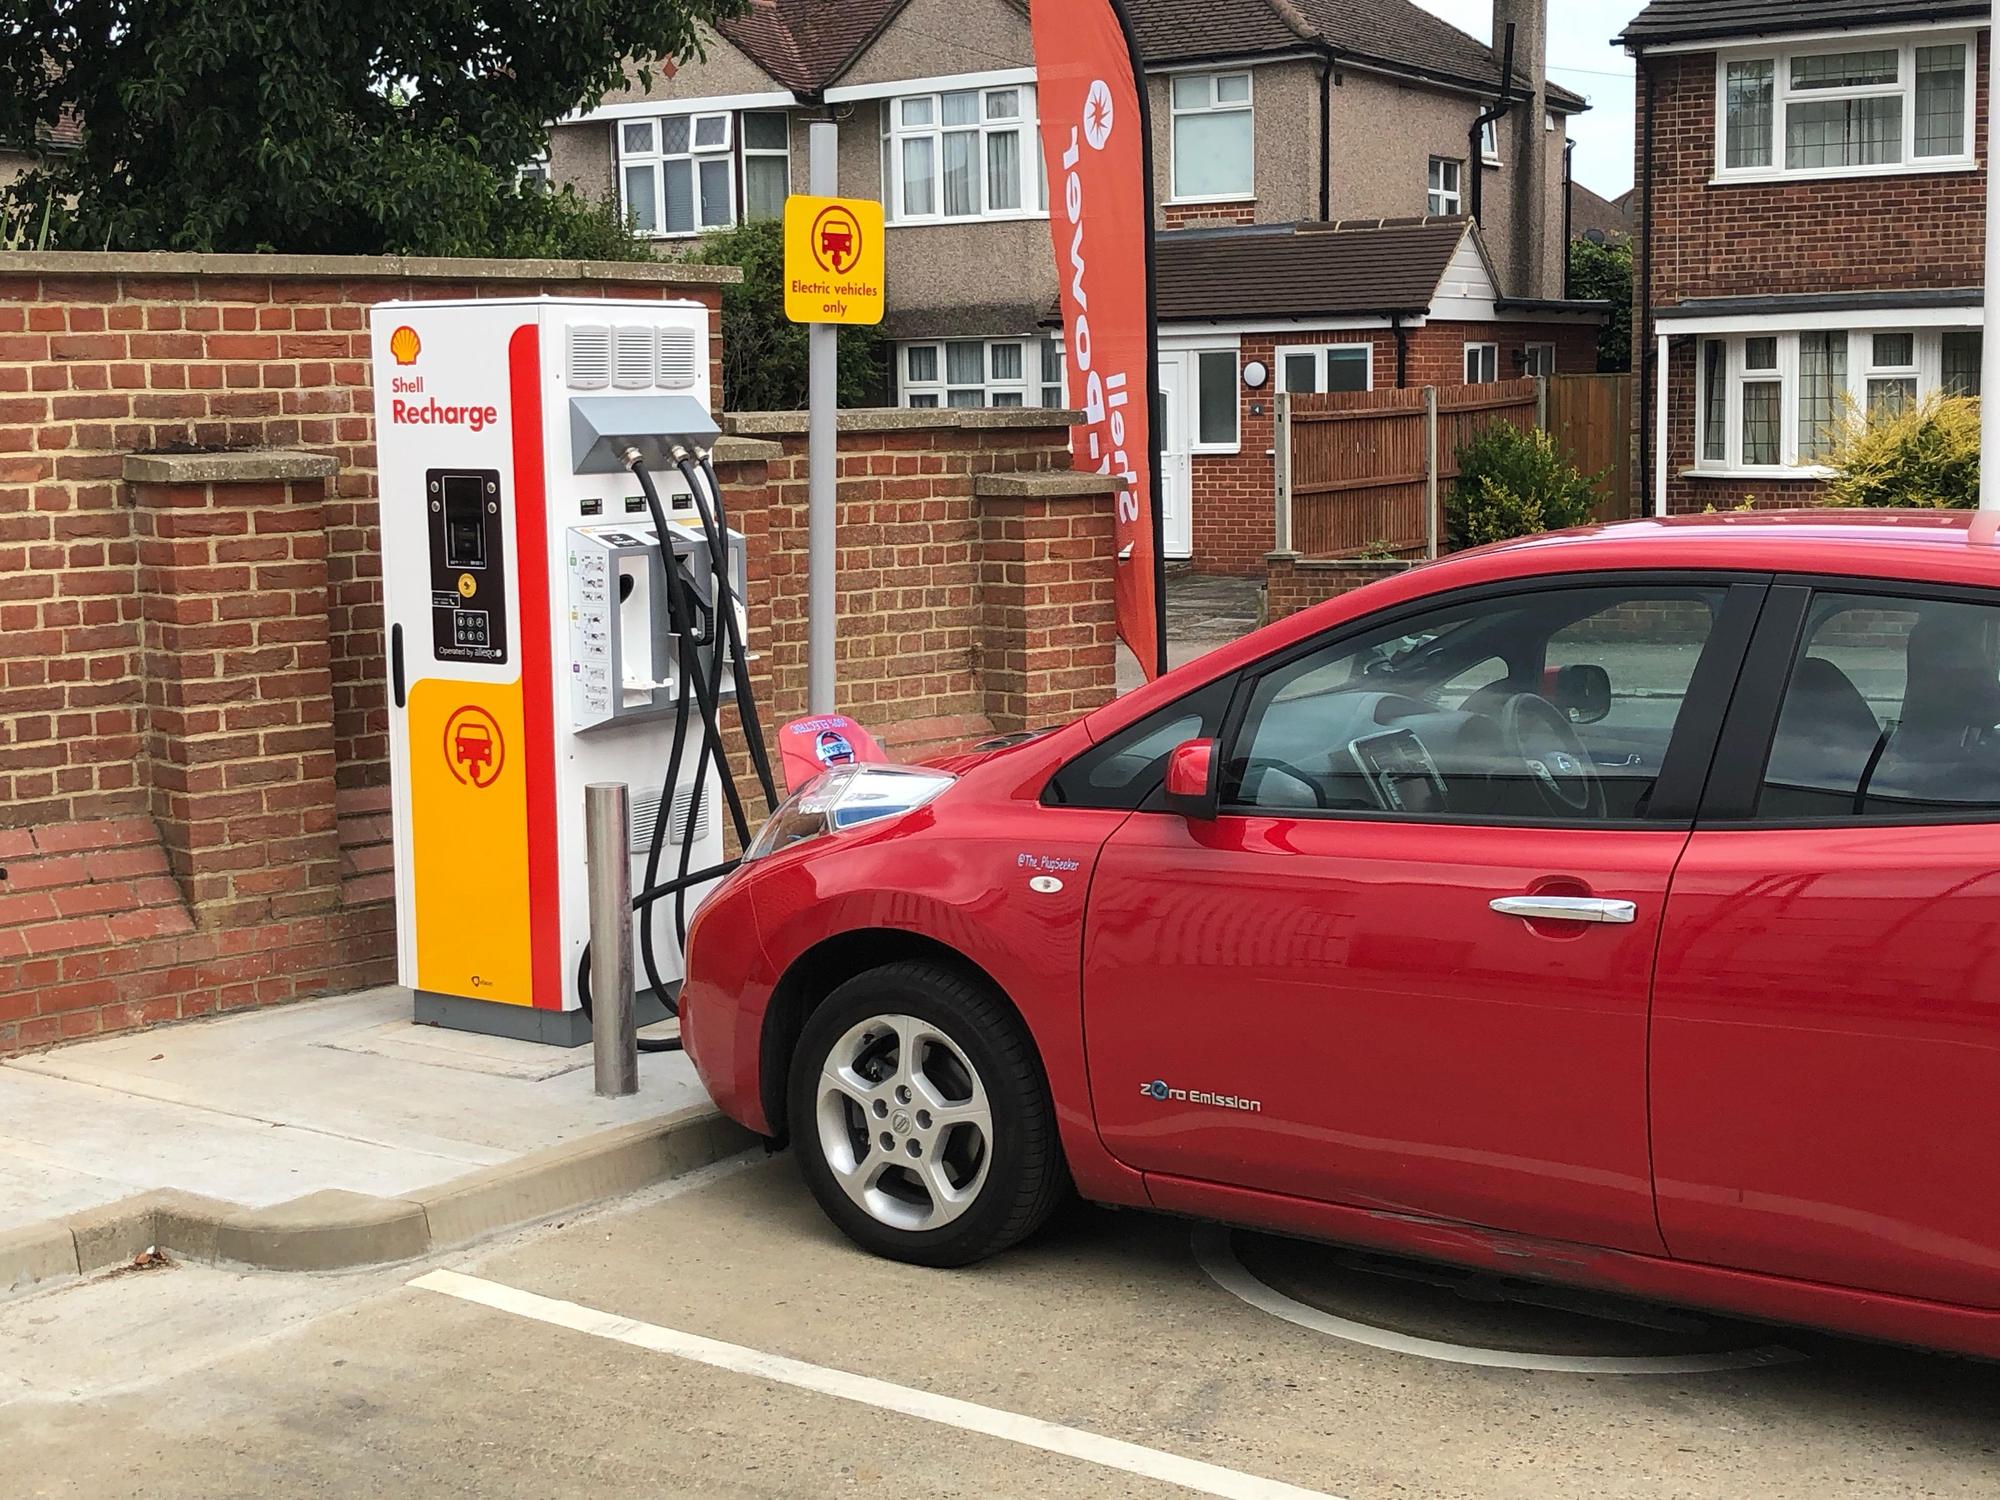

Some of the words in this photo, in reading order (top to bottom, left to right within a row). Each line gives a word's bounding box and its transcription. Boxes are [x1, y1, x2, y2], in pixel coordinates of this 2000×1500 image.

[792, 280, 830, 294] Electric
[834, 281, 878, 296] vehicles
[823, 300, 847, 317] only
[392, 376, 424, 393] Shell
[392, 397, 497, 432] Recharge
[439, 646, 465, 656] Operated
[466, 647, 473, 658] by
[1189, 1090, 1262, 1113] Emission
